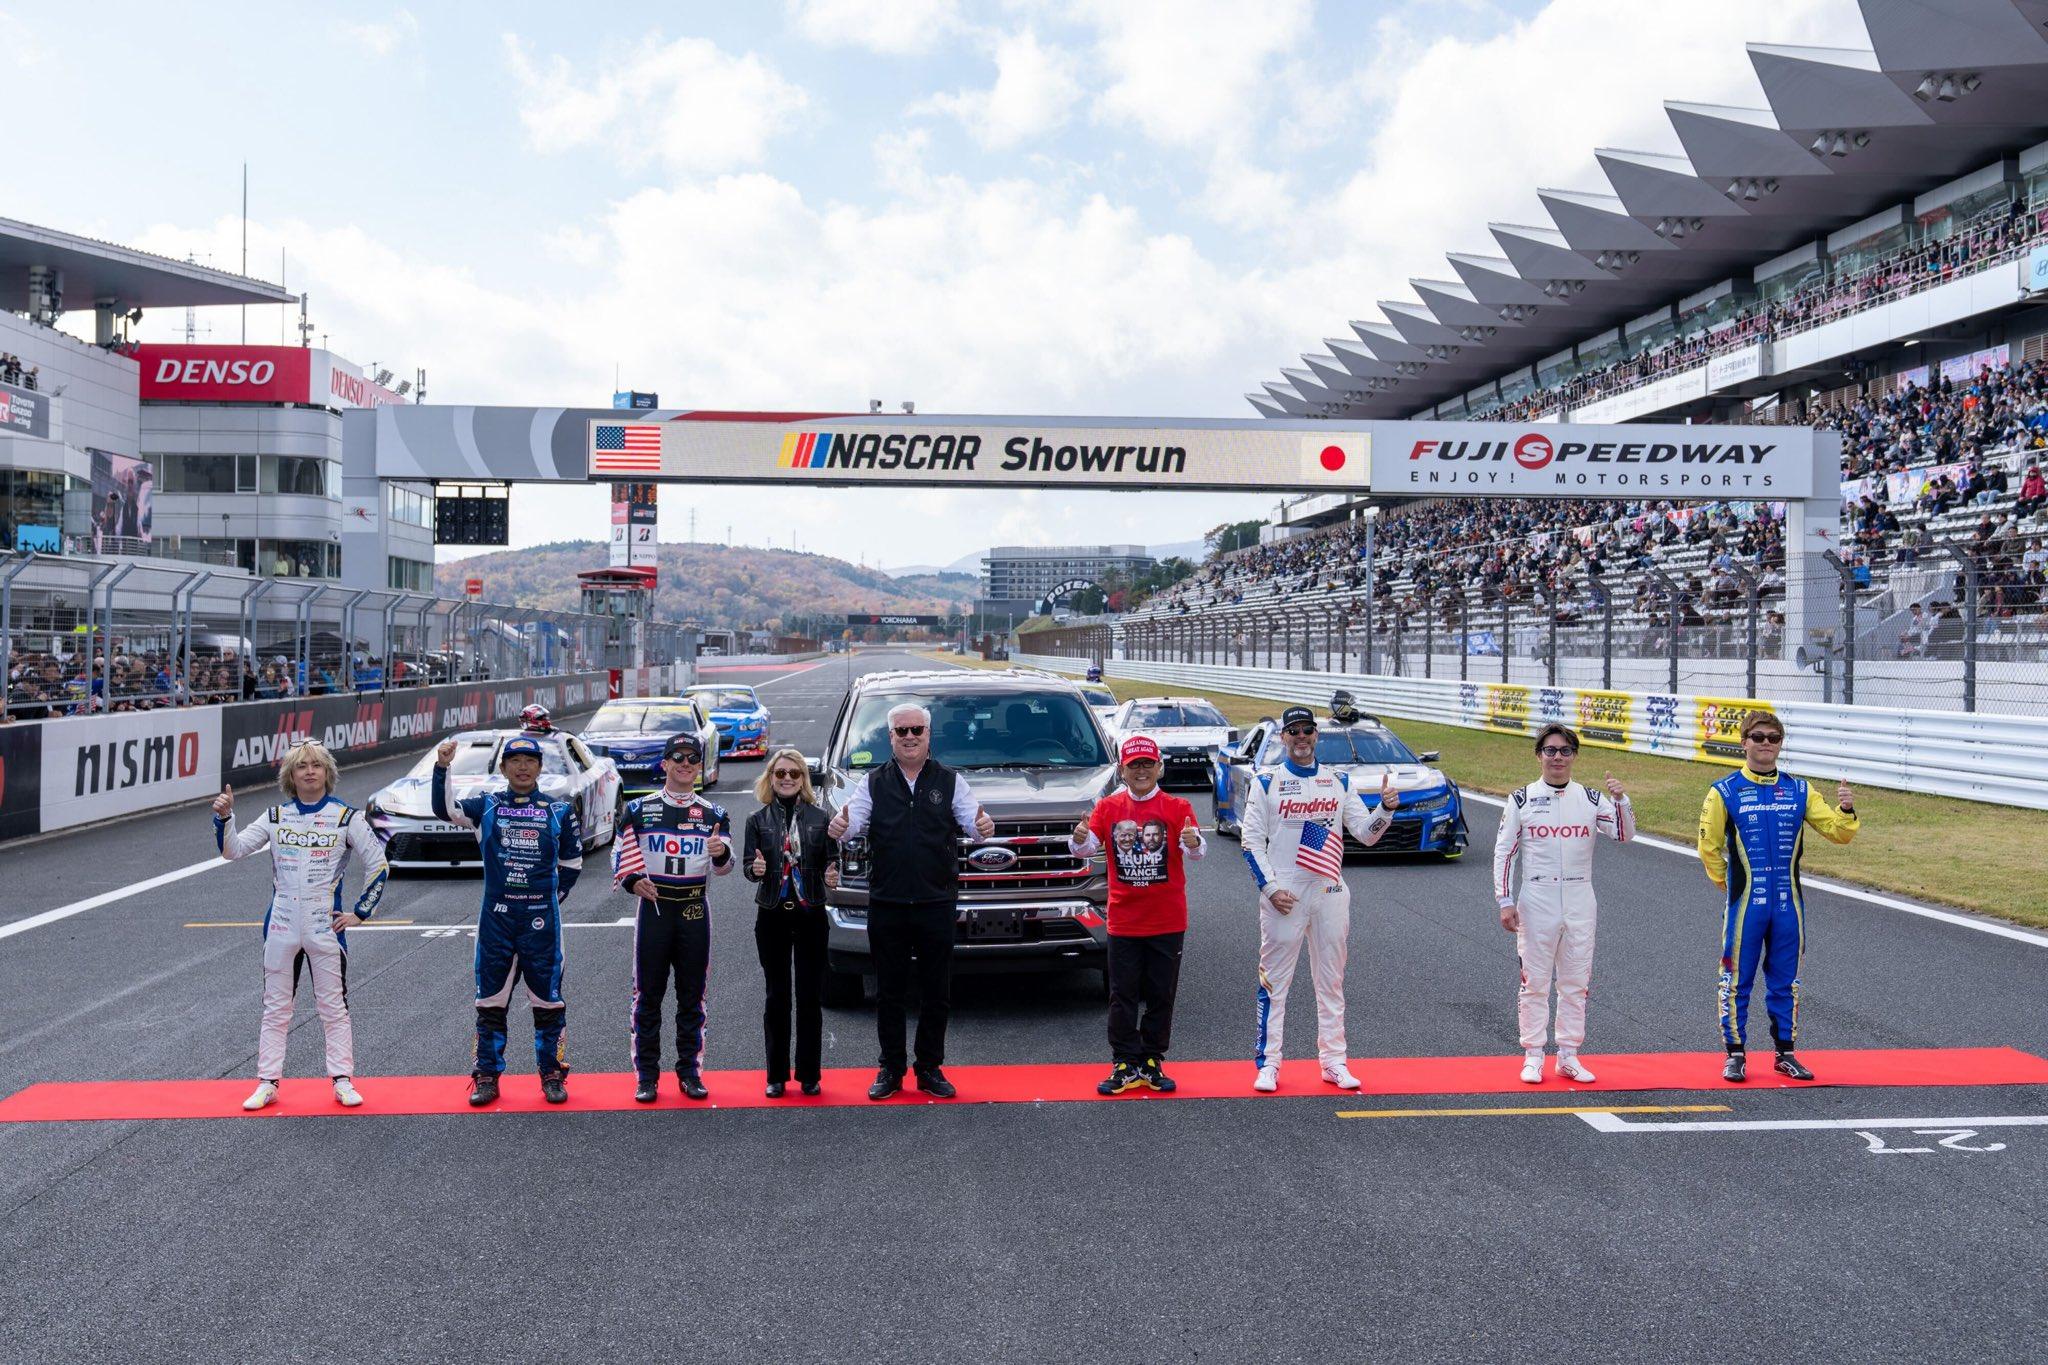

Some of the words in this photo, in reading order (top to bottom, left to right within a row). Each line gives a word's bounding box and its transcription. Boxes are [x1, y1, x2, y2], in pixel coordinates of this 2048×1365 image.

[155, 360, 275, 385] DENSO
[331, 367, 364, 406] DENSO
[827, 433, 980, 470] NASCAR
[1001, 438, 1186, 474] Showrun
[1409, 440, 1509, 461] FUJI
[1410, 471, 1516, 484] ENJOY!
[1555, 473, 1773, 487] MOTORSPORTS
[880, 616, 918, 624] YOKOHAMA
[389, 711, 433, 739] ADVAN
[442, 704, 478, 729] ADVAN
[324, 719, 378, 750] ADVAN
[1279, 797, 1338, 818] Hendrick
[278, 829, 337, 848] KeePer
[1528, 826, 1590, 838] TOYOTA
[649, 835, 704, 855] Mobil
[670, 858, 678, 875] 1
[982, 852, 1005, 863] Ford
[1117, 853, 1163, 866] TRUMP
[1124, 868, 1158, 876] VANCE
[682, 903, 704, 920] 42
